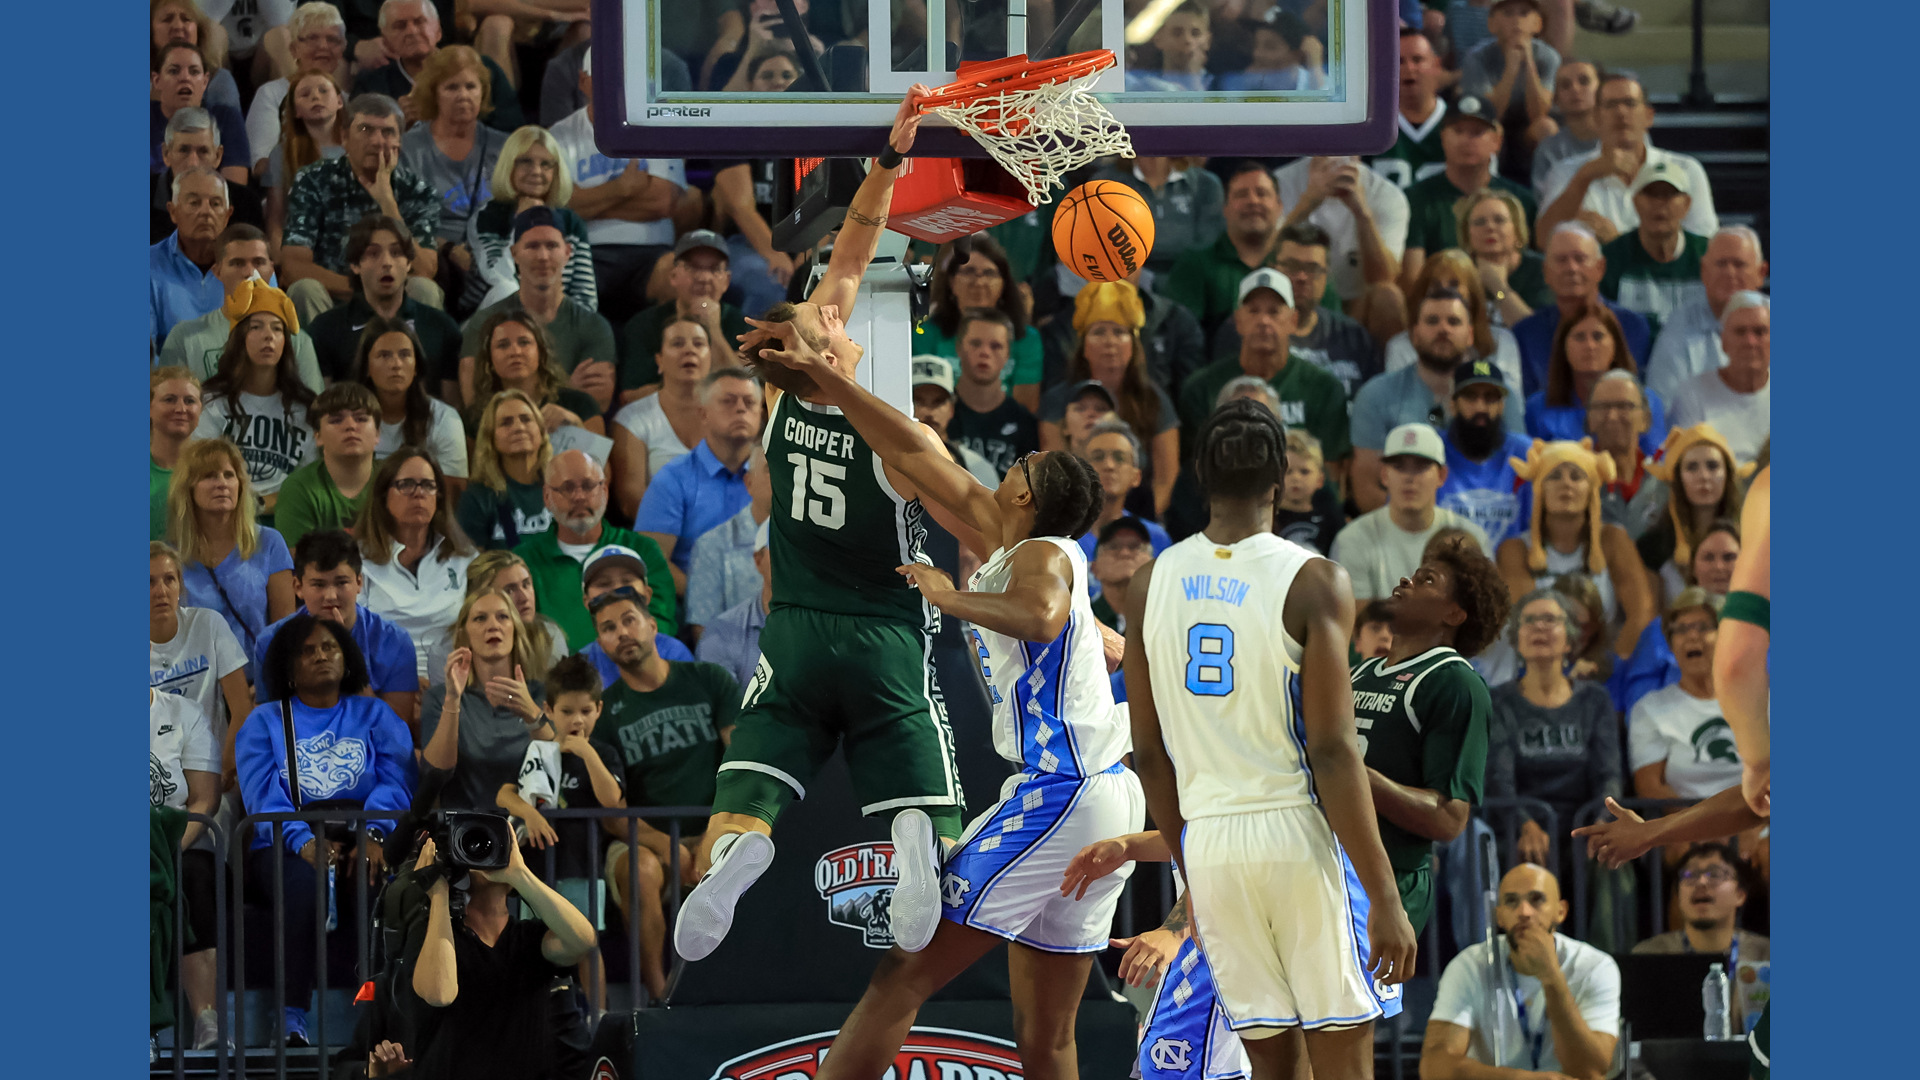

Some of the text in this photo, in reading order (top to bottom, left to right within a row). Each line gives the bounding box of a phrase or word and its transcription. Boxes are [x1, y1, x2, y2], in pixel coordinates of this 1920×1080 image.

[784, 416, 855, 460] COOPER
[787, 452, 847, 530] 15
[1181, 575, 1250, 607] WILSON
[1185, 622, 1234, 697] 8
[618, 703, 718, 767] STATE
[818, 859, 858, 891] OLD
